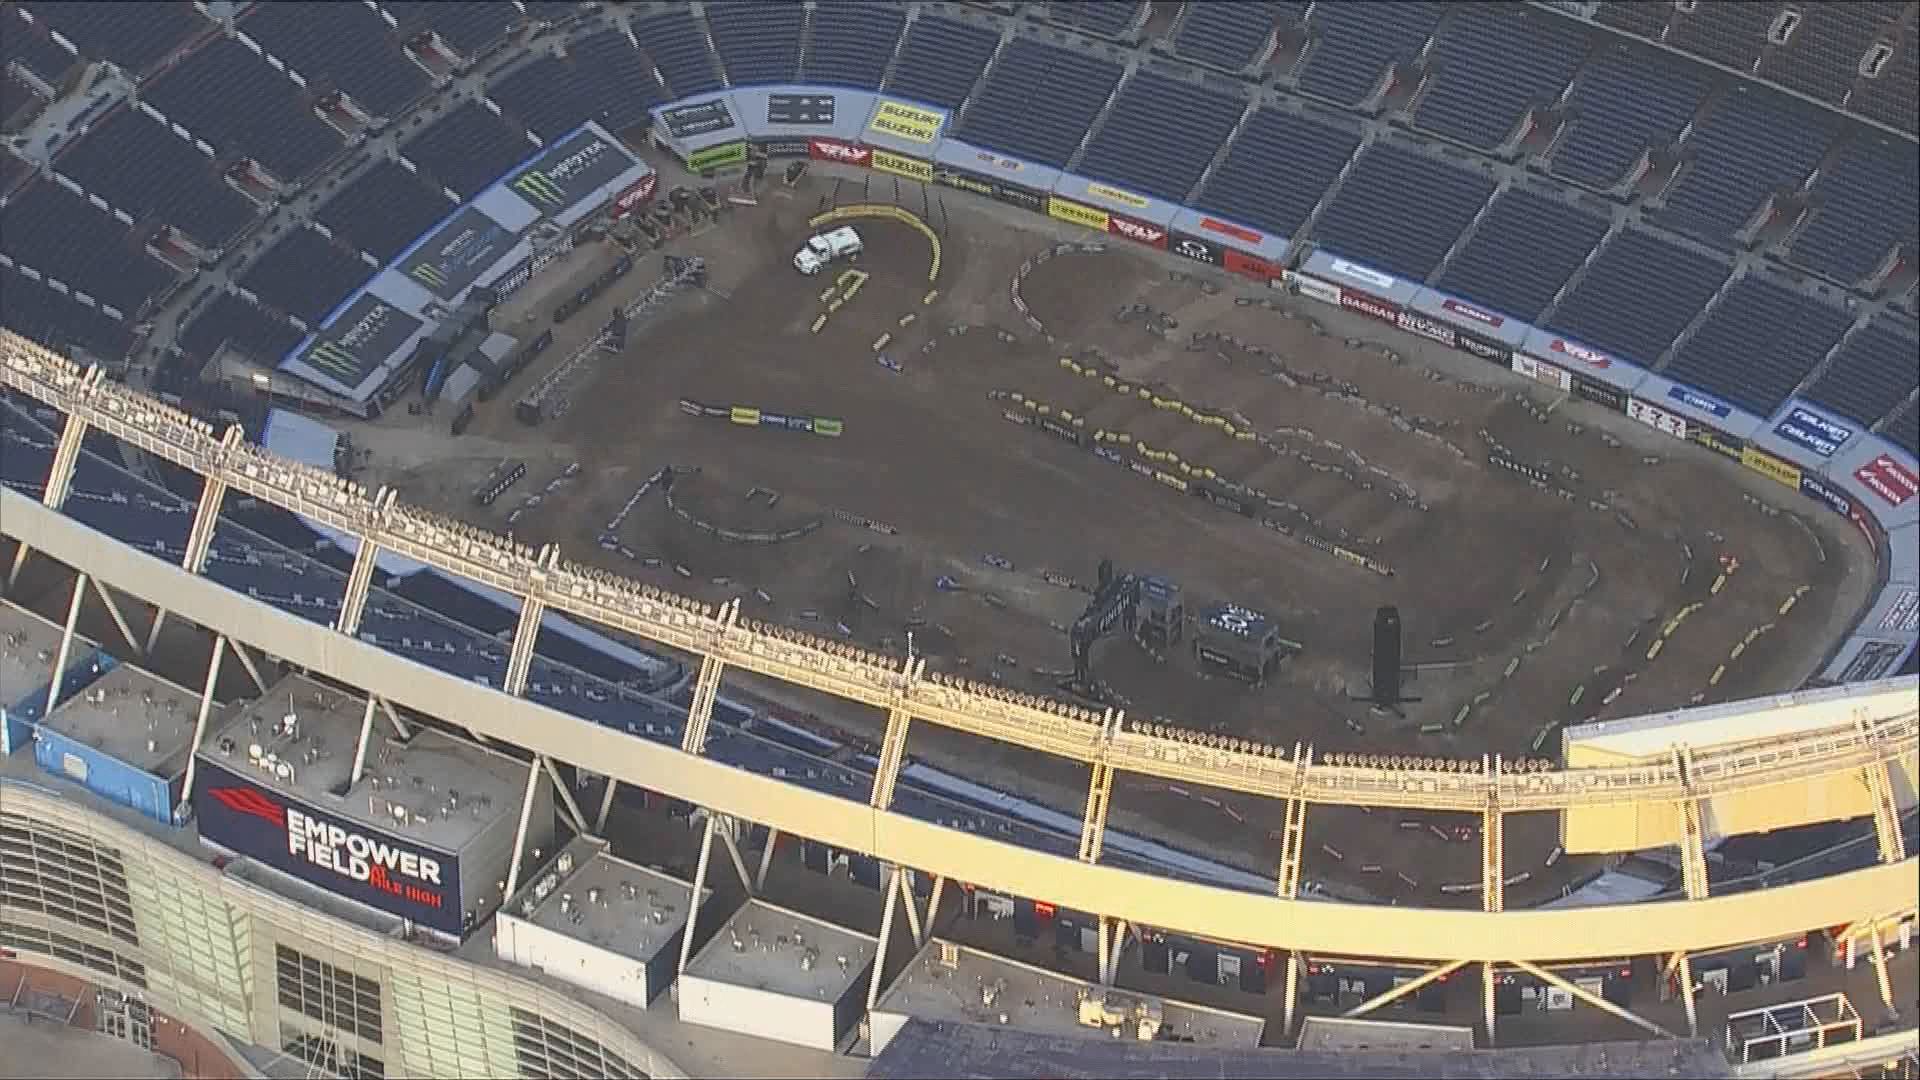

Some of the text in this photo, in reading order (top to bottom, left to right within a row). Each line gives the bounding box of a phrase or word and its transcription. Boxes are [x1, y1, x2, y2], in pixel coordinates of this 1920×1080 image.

[880, 104, 942, 126] SUZUKI
[875, 119, 934, 140] SUZUKI
[874, 154, 932, 178] SUZUKI
[287, 807, 441, 885] EMPOWER
[289, 832, 370, 881] FIELD
[406, 884, 442, 909] HIGH
